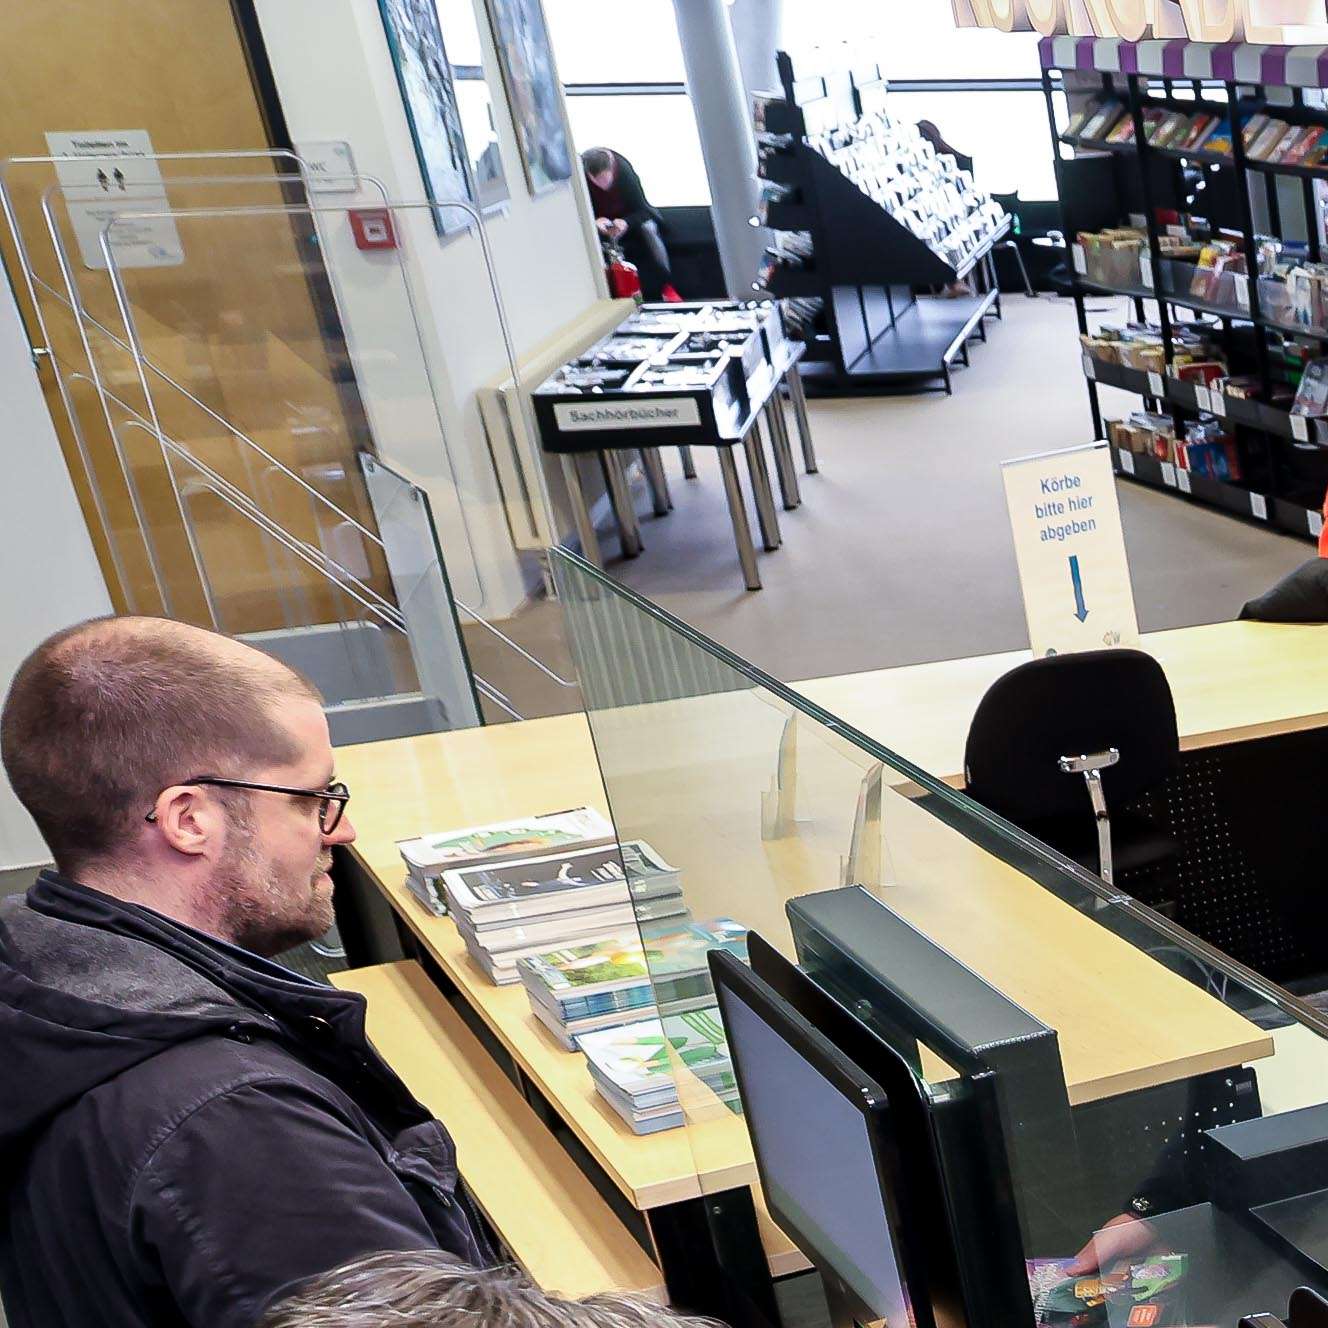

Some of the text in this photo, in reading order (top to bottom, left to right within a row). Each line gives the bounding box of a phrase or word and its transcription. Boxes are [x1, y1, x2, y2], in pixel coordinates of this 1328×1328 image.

[1040, 475, 1081, 494] Körbe
[1035, 496, 1093, 519] bitte hier
[1040, 519, 1096, 541] abgeben
